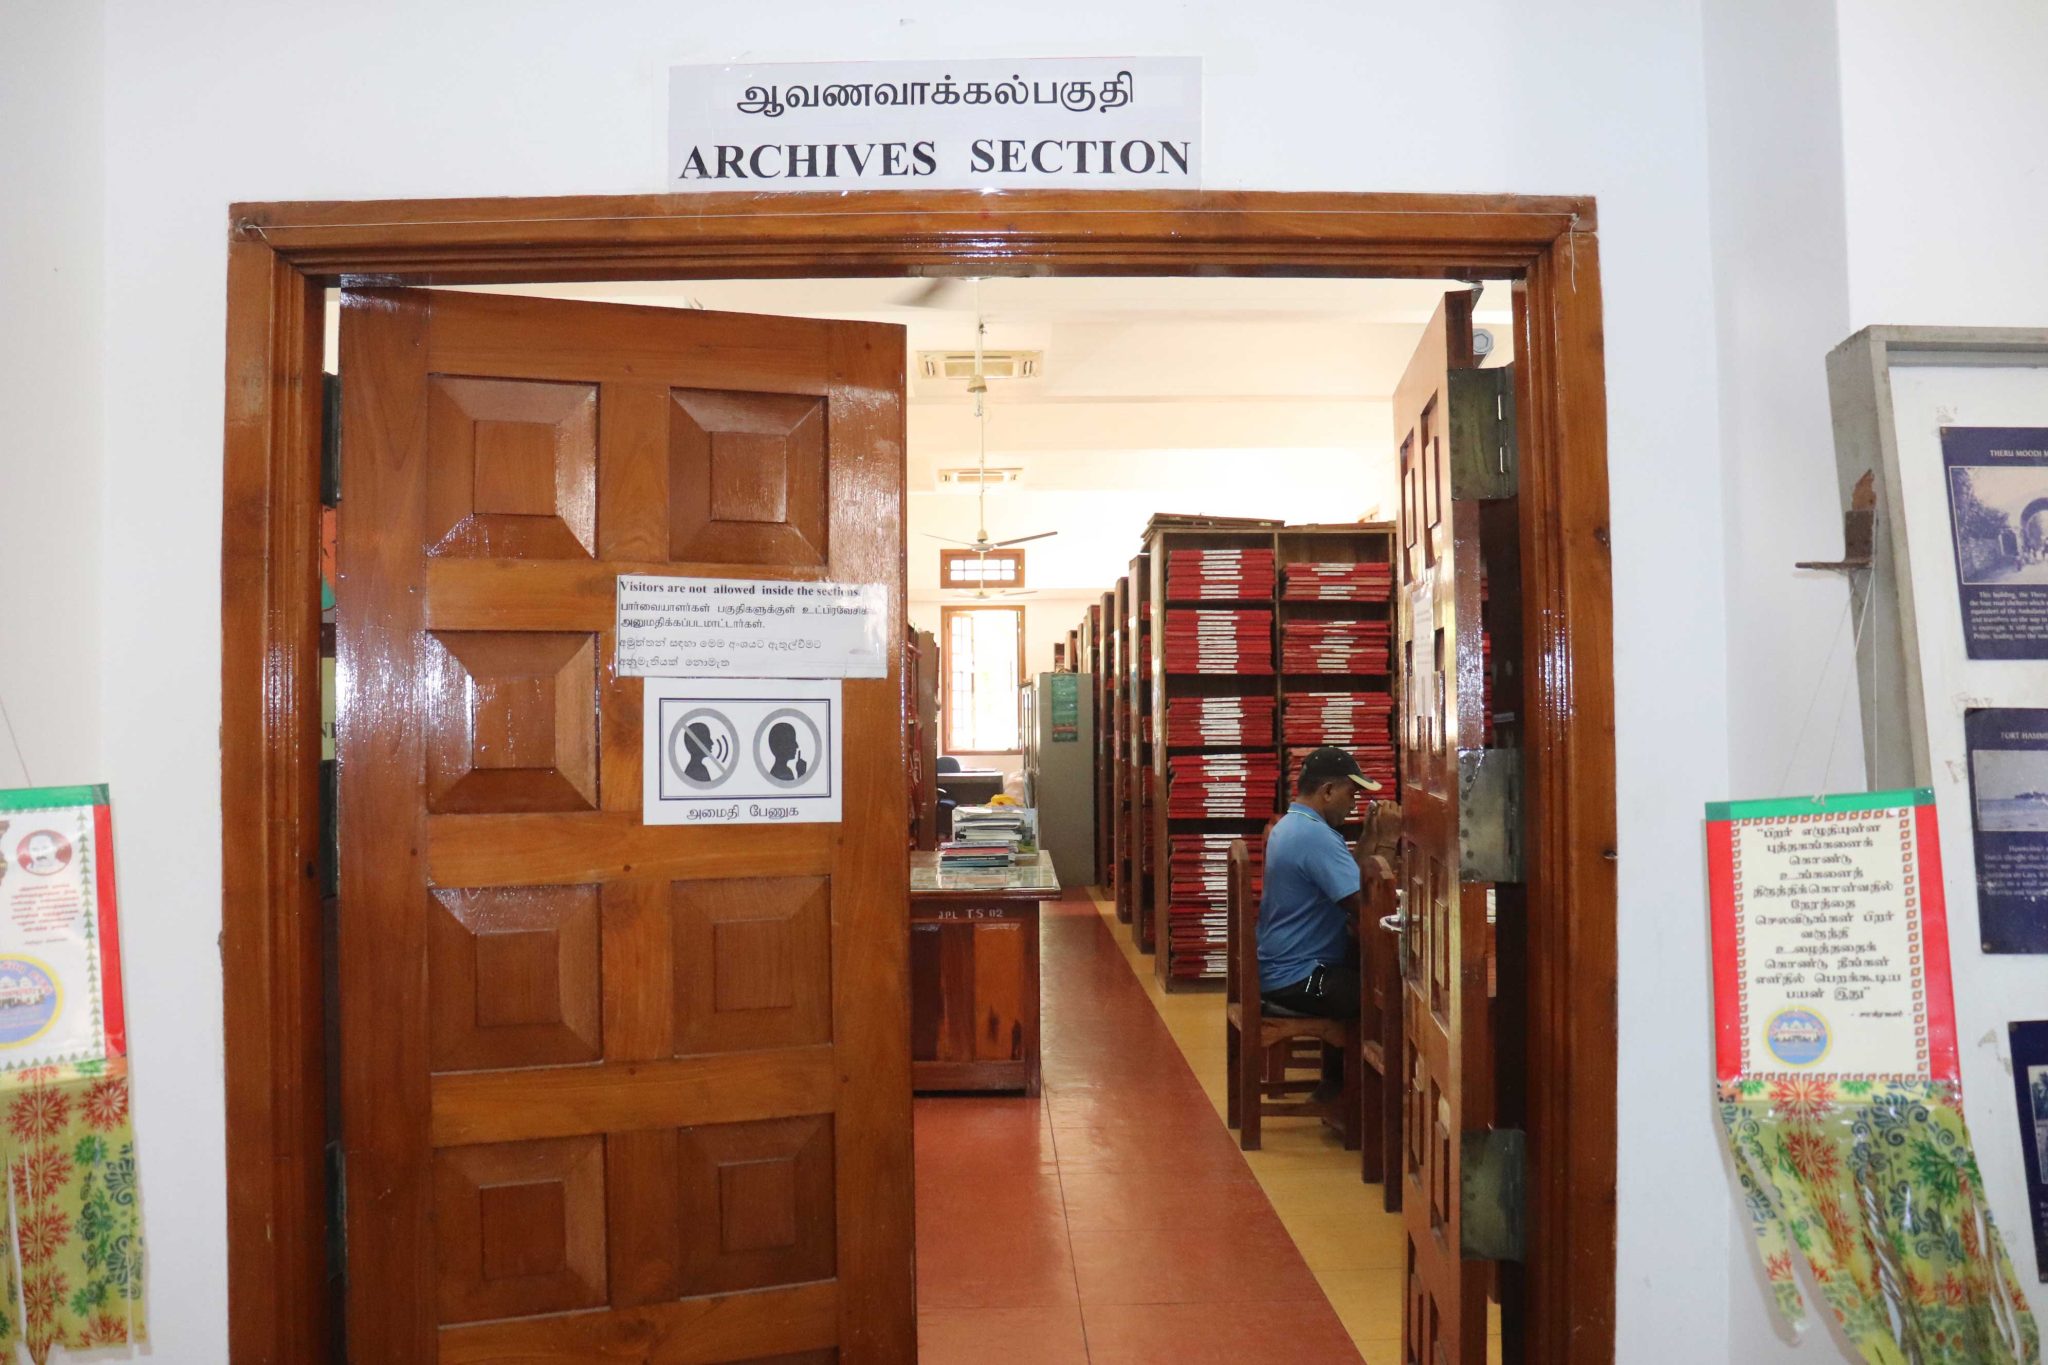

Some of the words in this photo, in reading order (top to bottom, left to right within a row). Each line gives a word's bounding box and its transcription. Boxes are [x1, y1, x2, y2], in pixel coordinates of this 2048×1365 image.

[736, 71, 1134, 118] ஆவணவாக்கல்பகுதி
[678, 141, 937, 180] ARCHIVES
[970, 139, 1191, 176] SECTION
[620, 580, 664, 593] Visitors
[667, 585, 686, 593] are
[689, 585, 707, 594] not
[713, 585, 756, 595] allowed
[762, 586, 794, 595] inside
[797, 586, 814, 596] the
[686, 804, 740, 821] அமைதி
[749, 804, 800, 820] பேணுக
